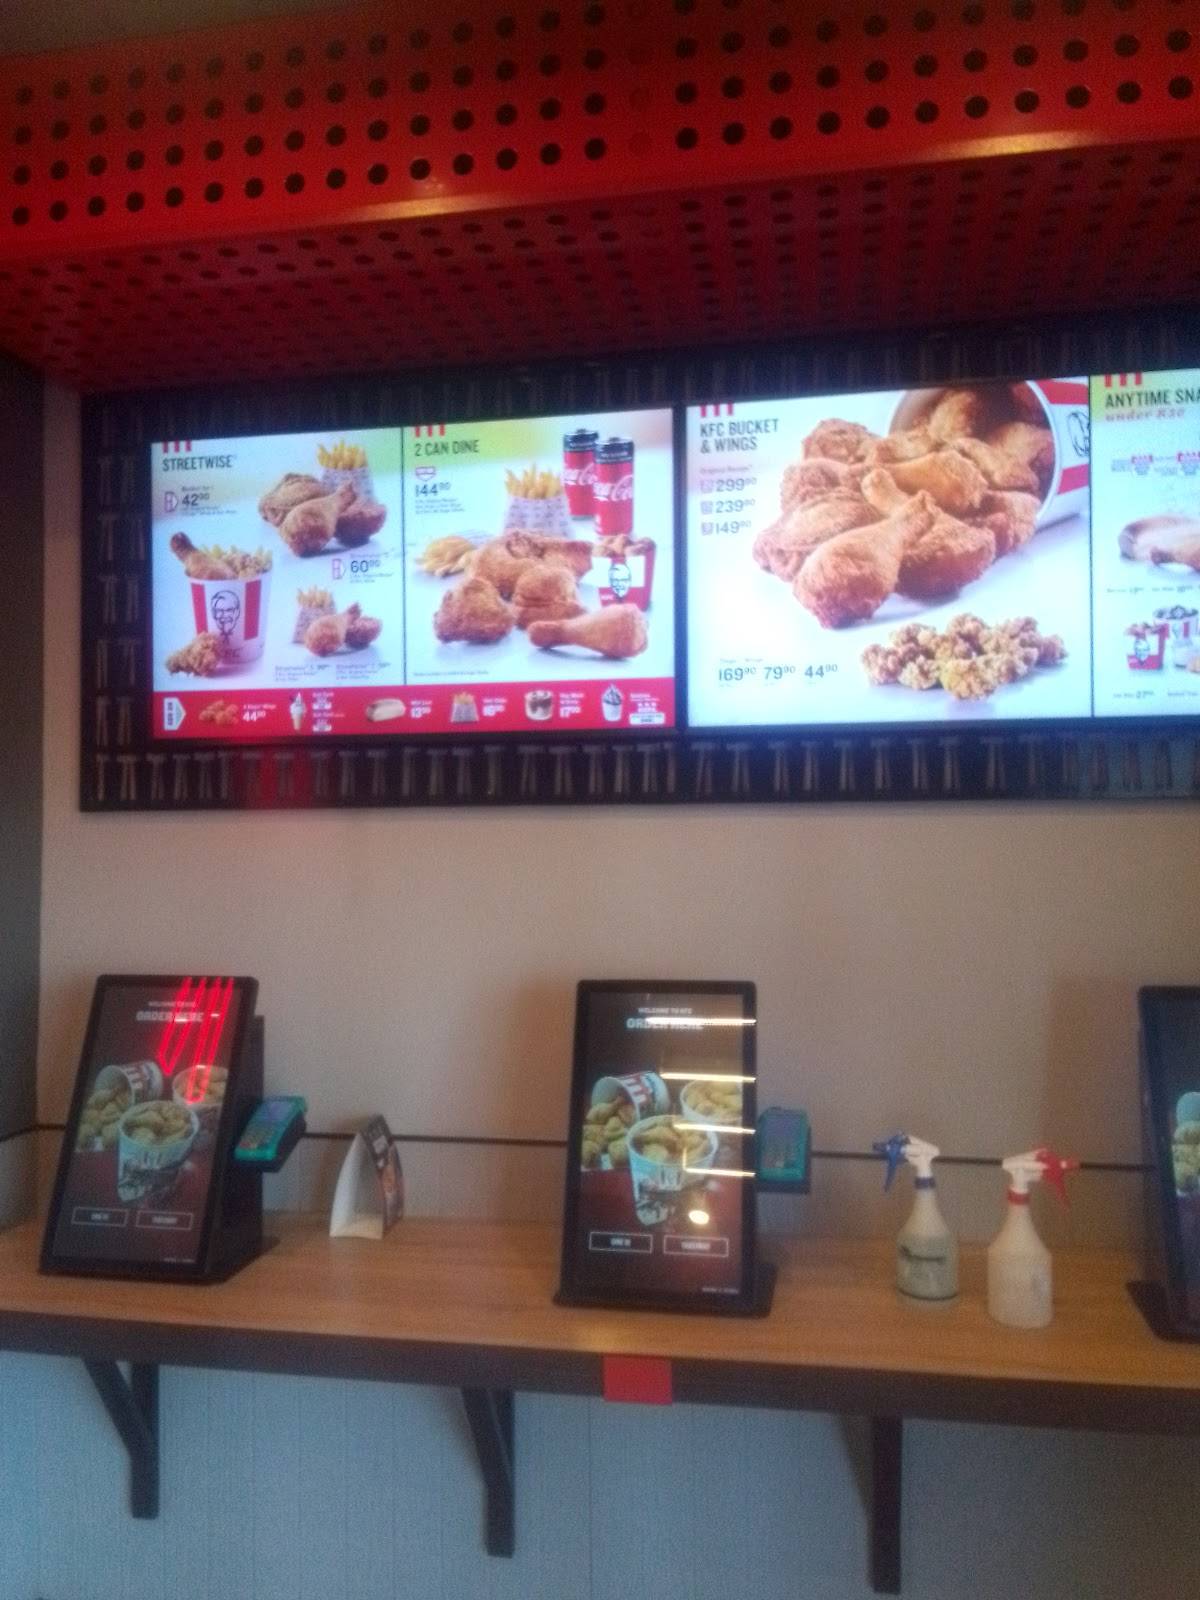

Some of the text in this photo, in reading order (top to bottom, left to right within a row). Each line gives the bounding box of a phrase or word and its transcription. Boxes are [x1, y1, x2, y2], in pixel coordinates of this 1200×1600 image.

[1105, 389, 1171, 408] ANYTIME
[700, 418, 779, 437] KFC BUCKET
[414, 440, 480, 457] 2 CAN DINE
[700, 436, 757, 454] & WINGS
[162, 455, 233, 472] STREETWISE
